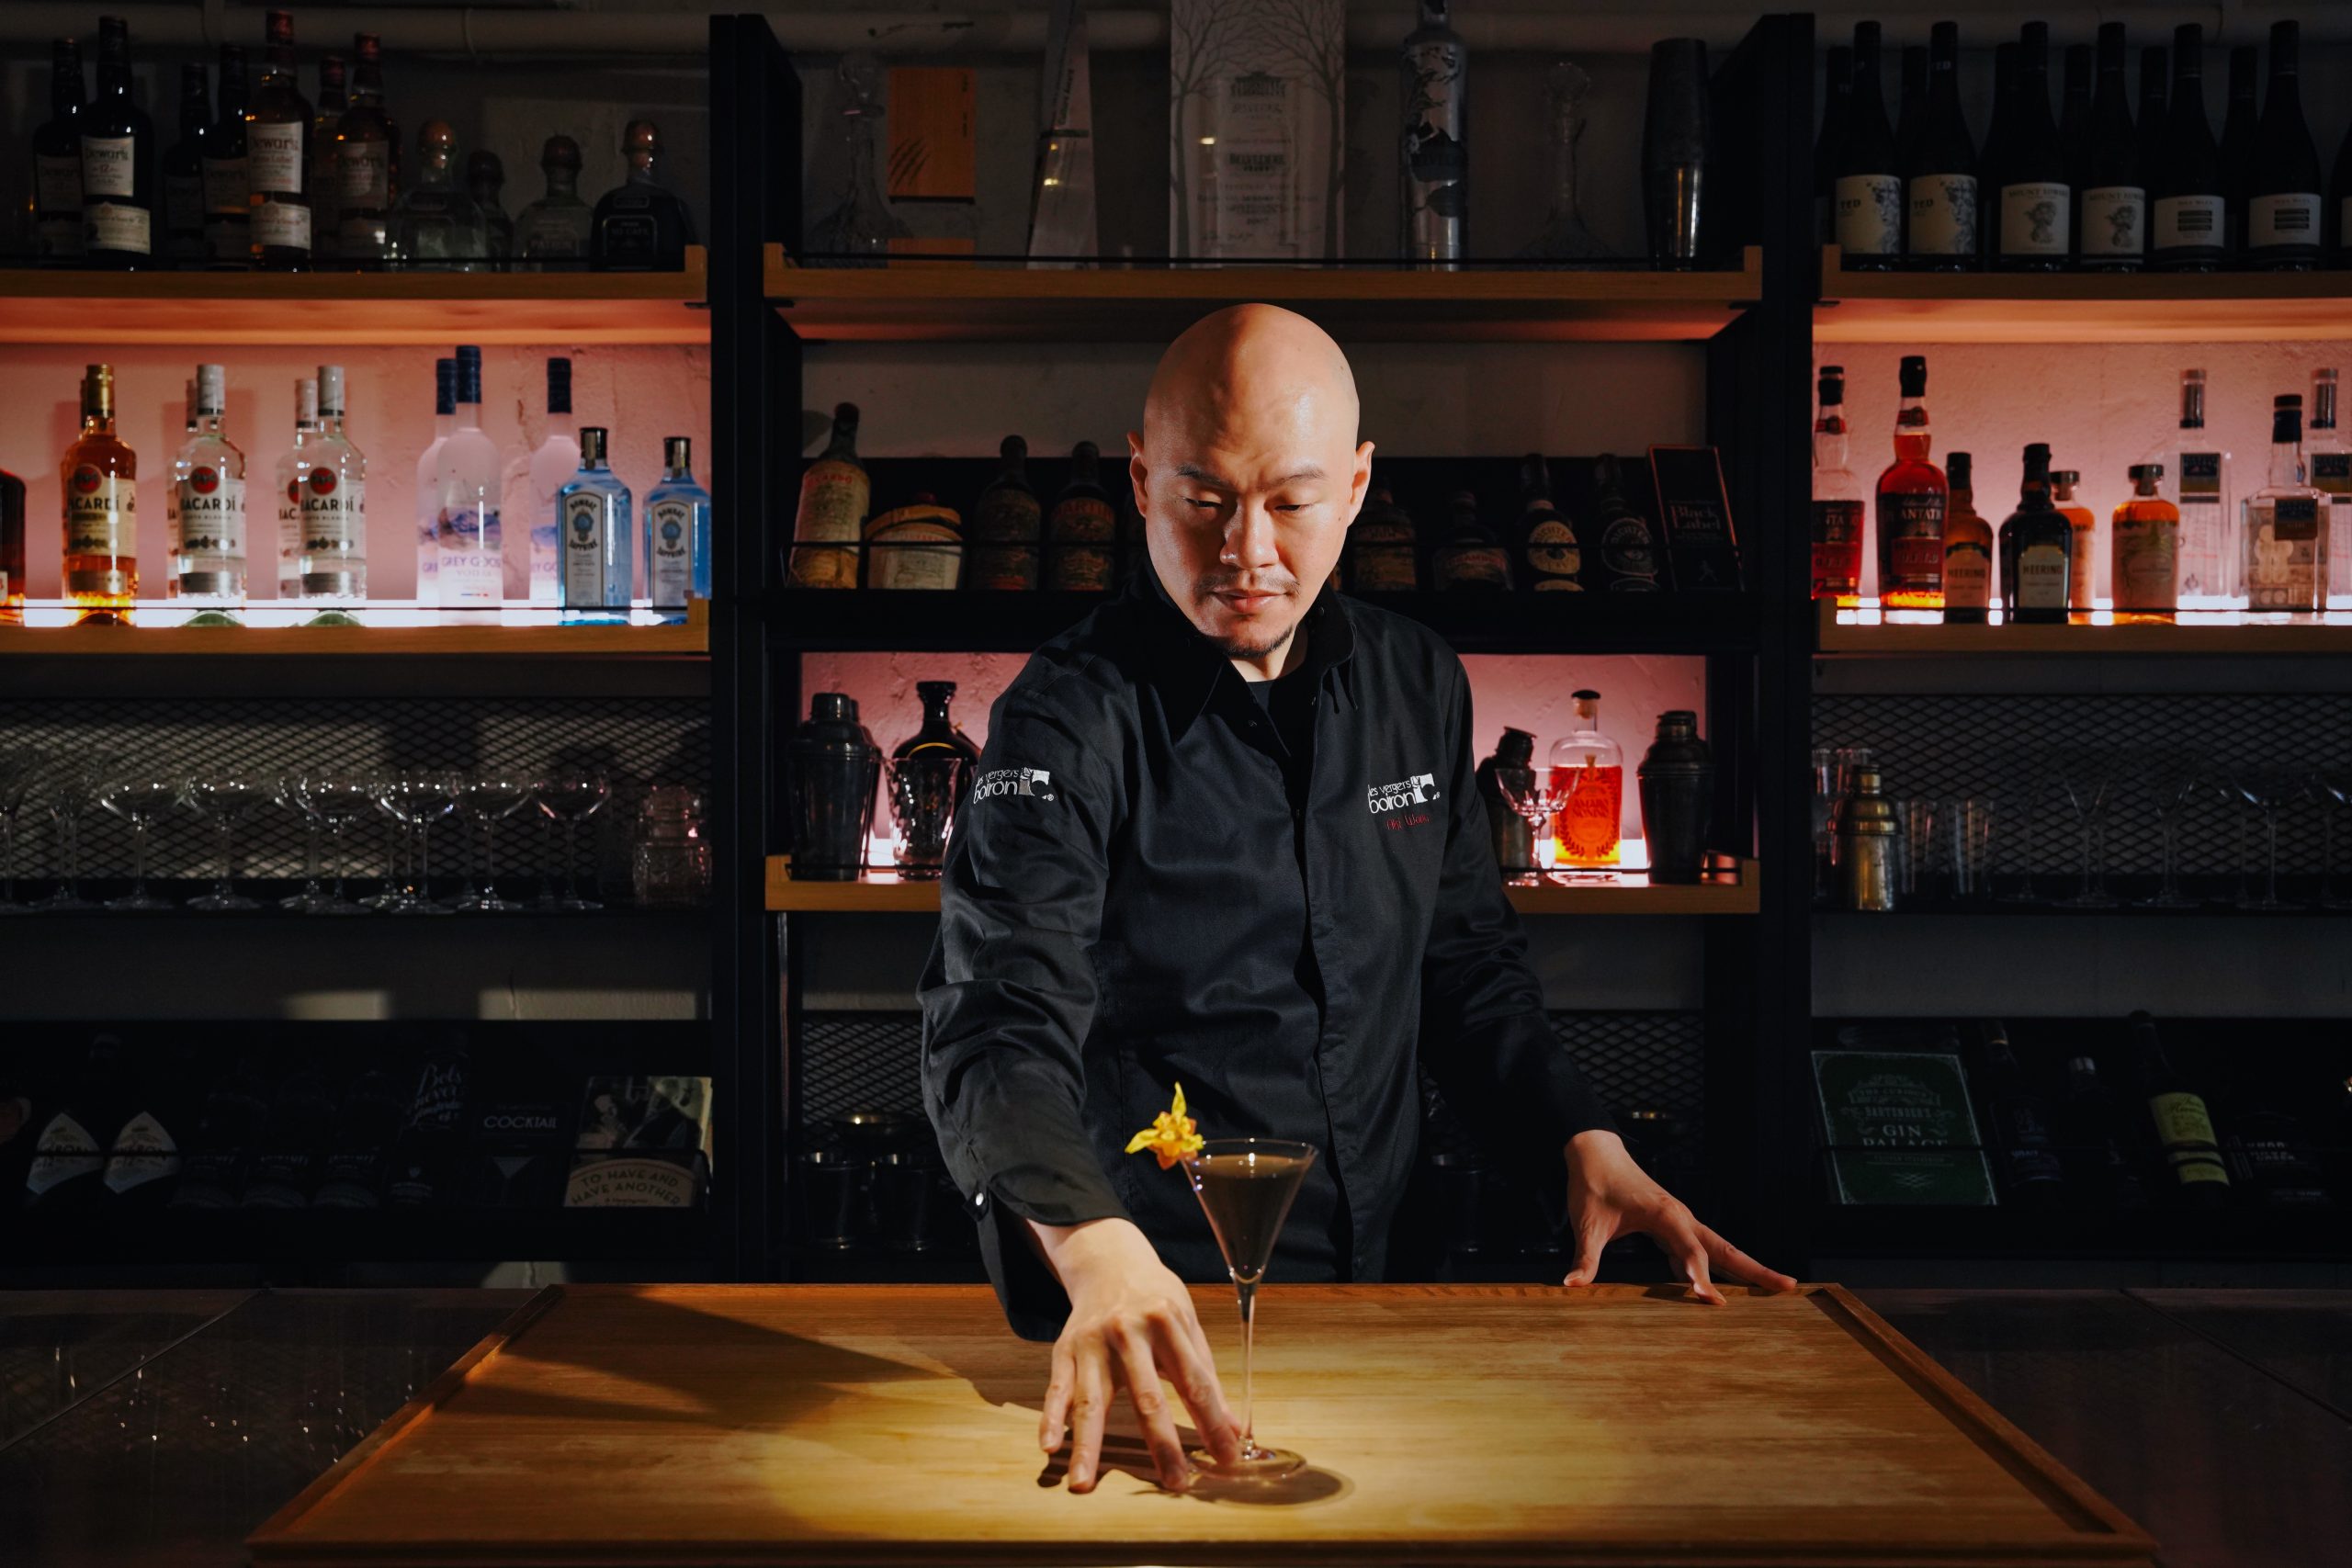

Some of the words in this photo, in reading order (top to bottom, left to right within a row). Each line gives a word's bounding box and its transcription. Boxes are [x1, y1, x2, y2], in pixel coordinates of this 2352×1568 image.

[1840, 198, 1860, 209] TED
[1913, 198, 1933, 209] TED
[571, 499, 597, 511] BOMBAY
[1670, 504, 1716, 518] Black
[658, 508, 684, 520] BOMBAY
[1673, 515, 1721, 530] Label
[569, 538, 598, 551] SAPPHIRE
[657, 546, 686, 558] SAPPHIRE
[1947, 569, 1985, 578] HEERING
[2022, 565, 2063, 575] HEERING
[986, 769, 1020, 781] vergers
[974, 780, 1018, 805] boiron
[1368, 784, 1378, 796] les
[1379, 780, 1411, 795] vergers
[1368, 792, 1416, 814] boiron
[1882, 1124, 1921, 1137] GIN
[581, 1173, 602, 1187] TO
[608, 1168, 646, 1180] HAVE
[649, 1172, 679, 1188] AND
[571, 1183, 609, 1205] HAVE
[615, 1181, 682, 1205] ANOTHER
